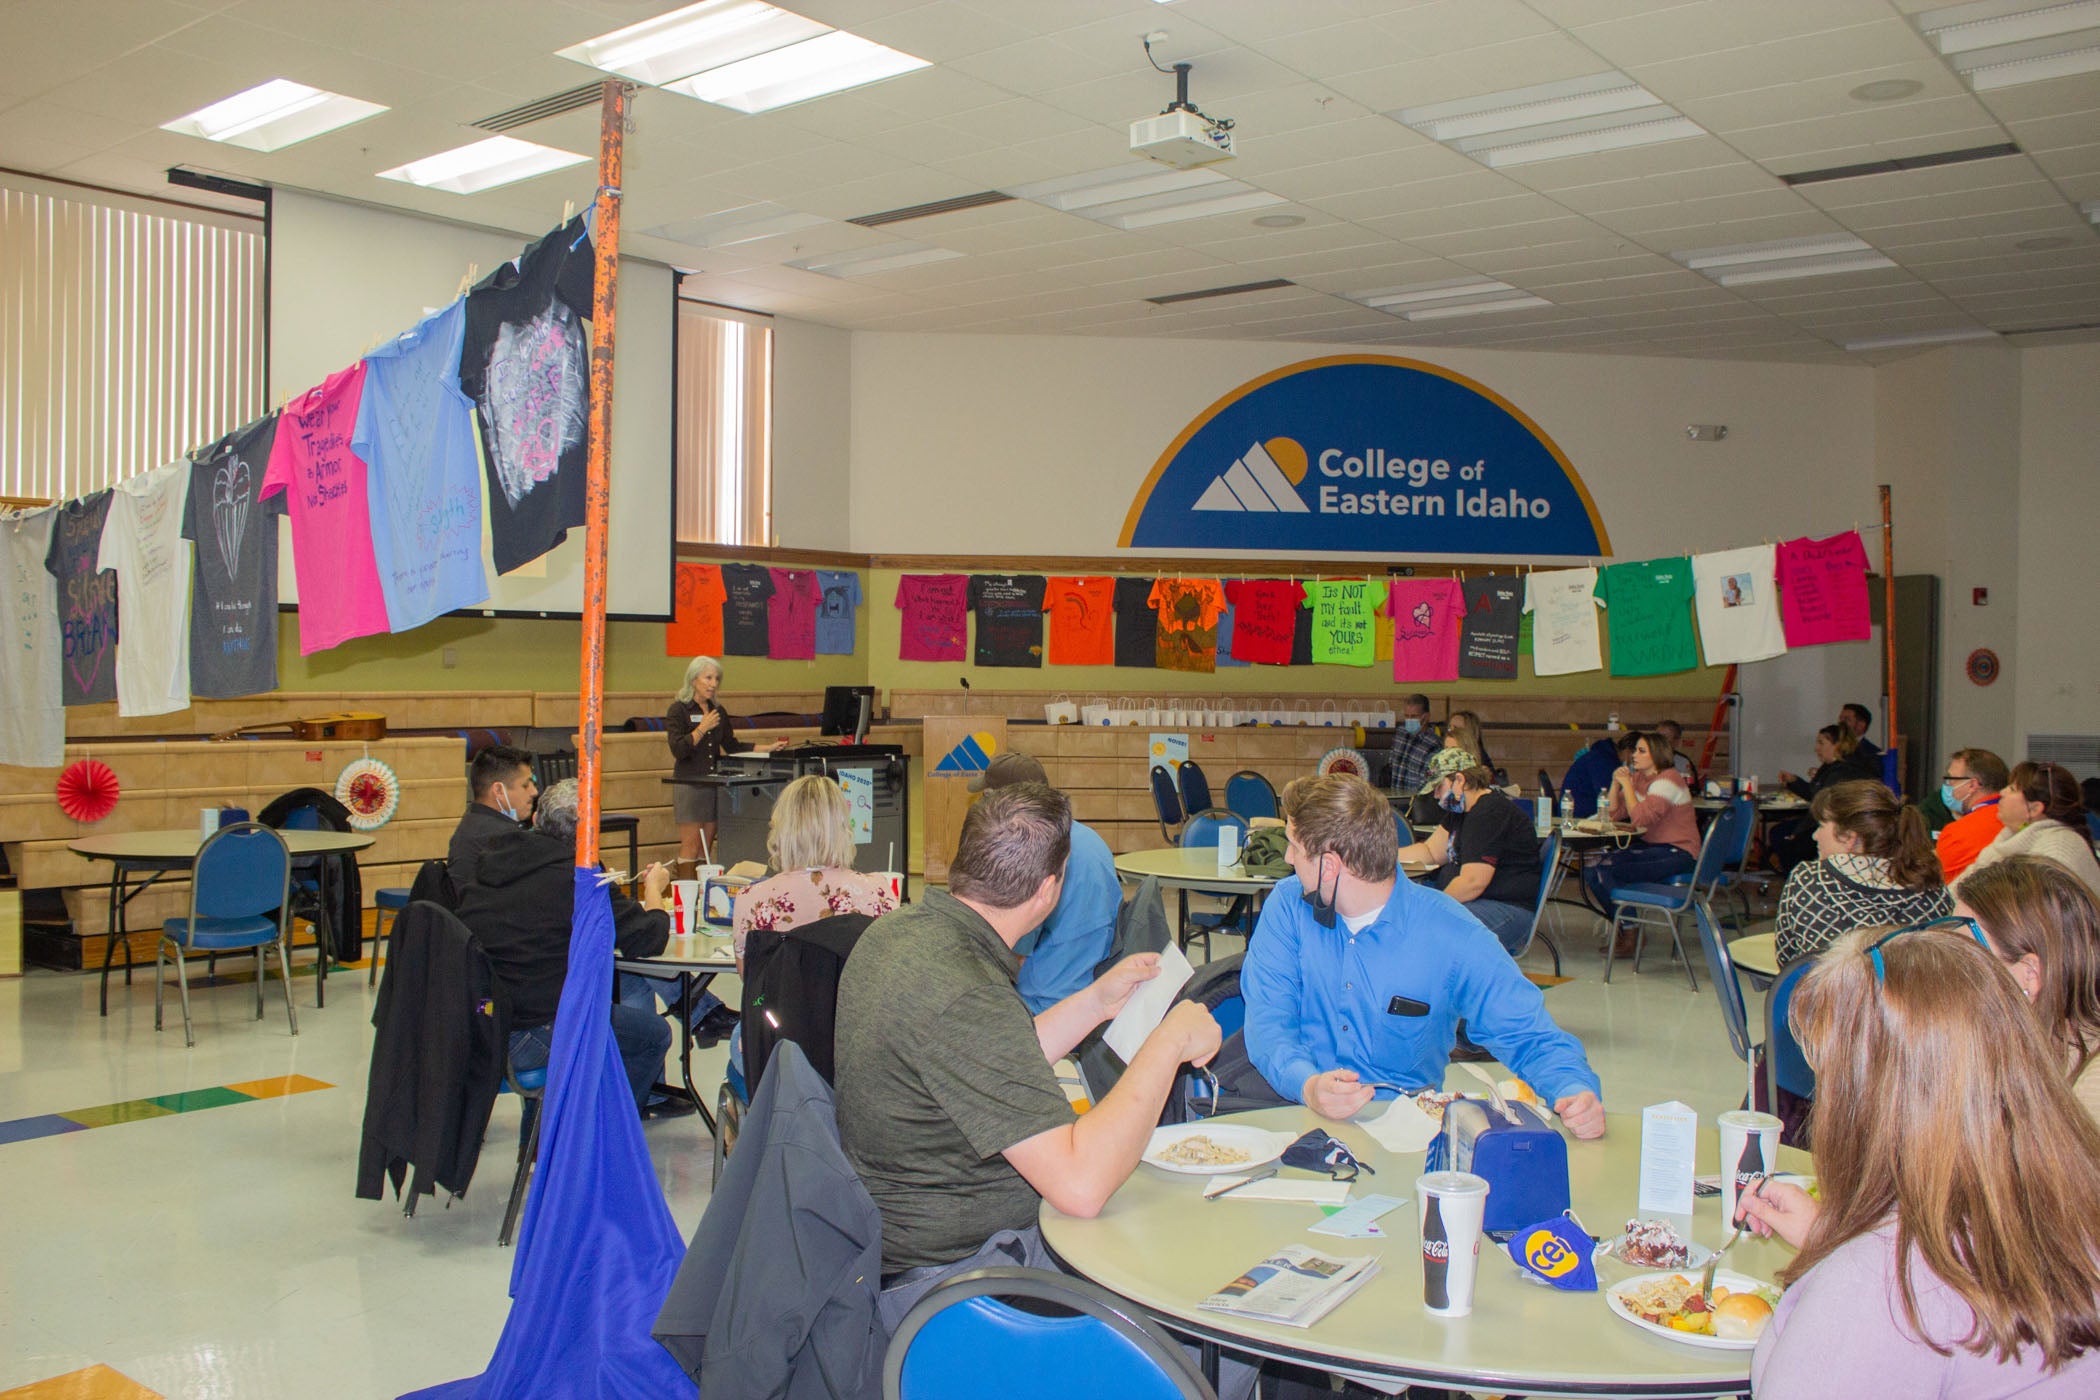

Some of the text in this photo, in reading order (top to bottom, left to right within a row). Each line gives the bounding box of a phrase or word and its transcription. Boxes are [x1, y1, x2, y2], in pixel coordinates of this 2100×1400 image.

[1318, 448, 1485, 488] College of
[1319, 485, 1551, 518] Eastern Idaho
[1342, 584, 1367, 599] NOT
[1321, 616, 1336, 628] and
[1330, 629, 1364, 645] YOURS
